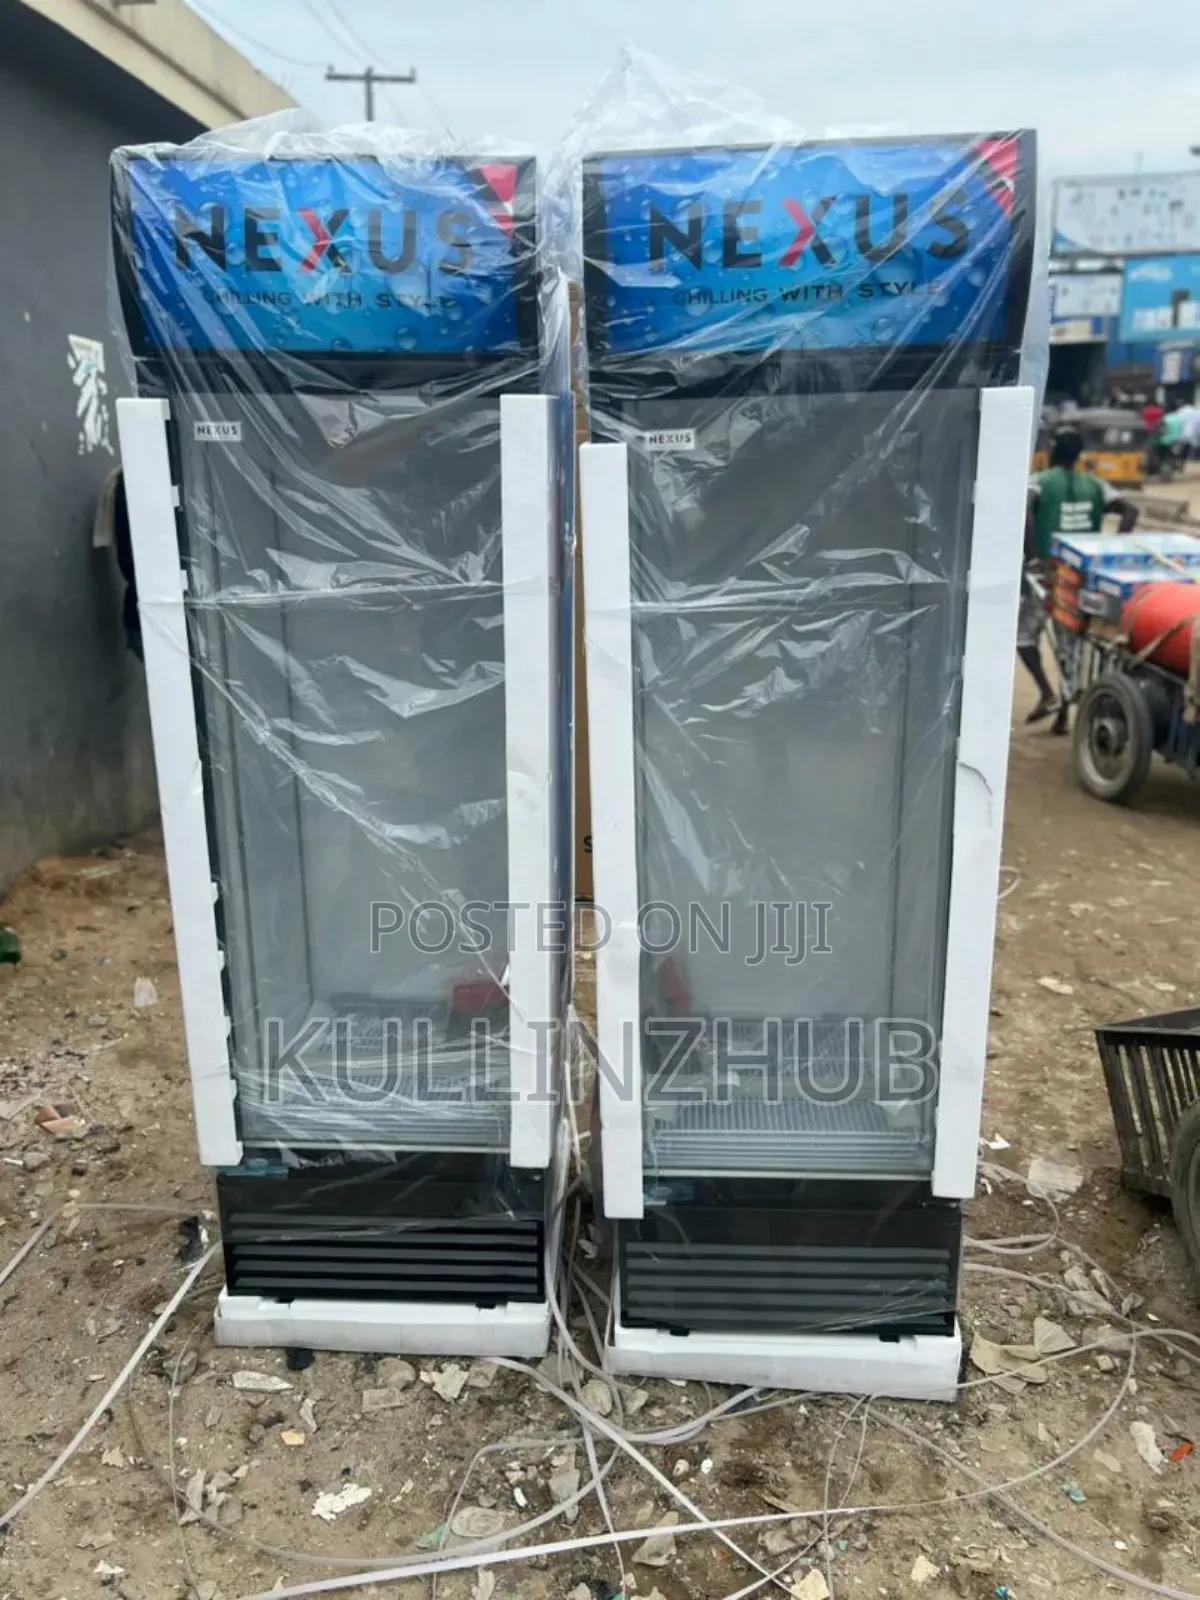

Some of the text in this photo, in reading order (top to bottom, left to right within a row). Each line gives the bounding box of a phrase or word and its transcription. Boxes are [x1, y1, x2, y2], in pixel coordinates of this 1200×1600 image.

[648, 187, 970, 272] NEXUS
[174, 206, 476, 276] NEXUS
[303, 292, 362, 309] WITH
[672, 280, 942, 306] CHILLING WITH STYLE
[197, 425, 238, 436] NEXUS
[648, 433, 692, 445] NEXUS
